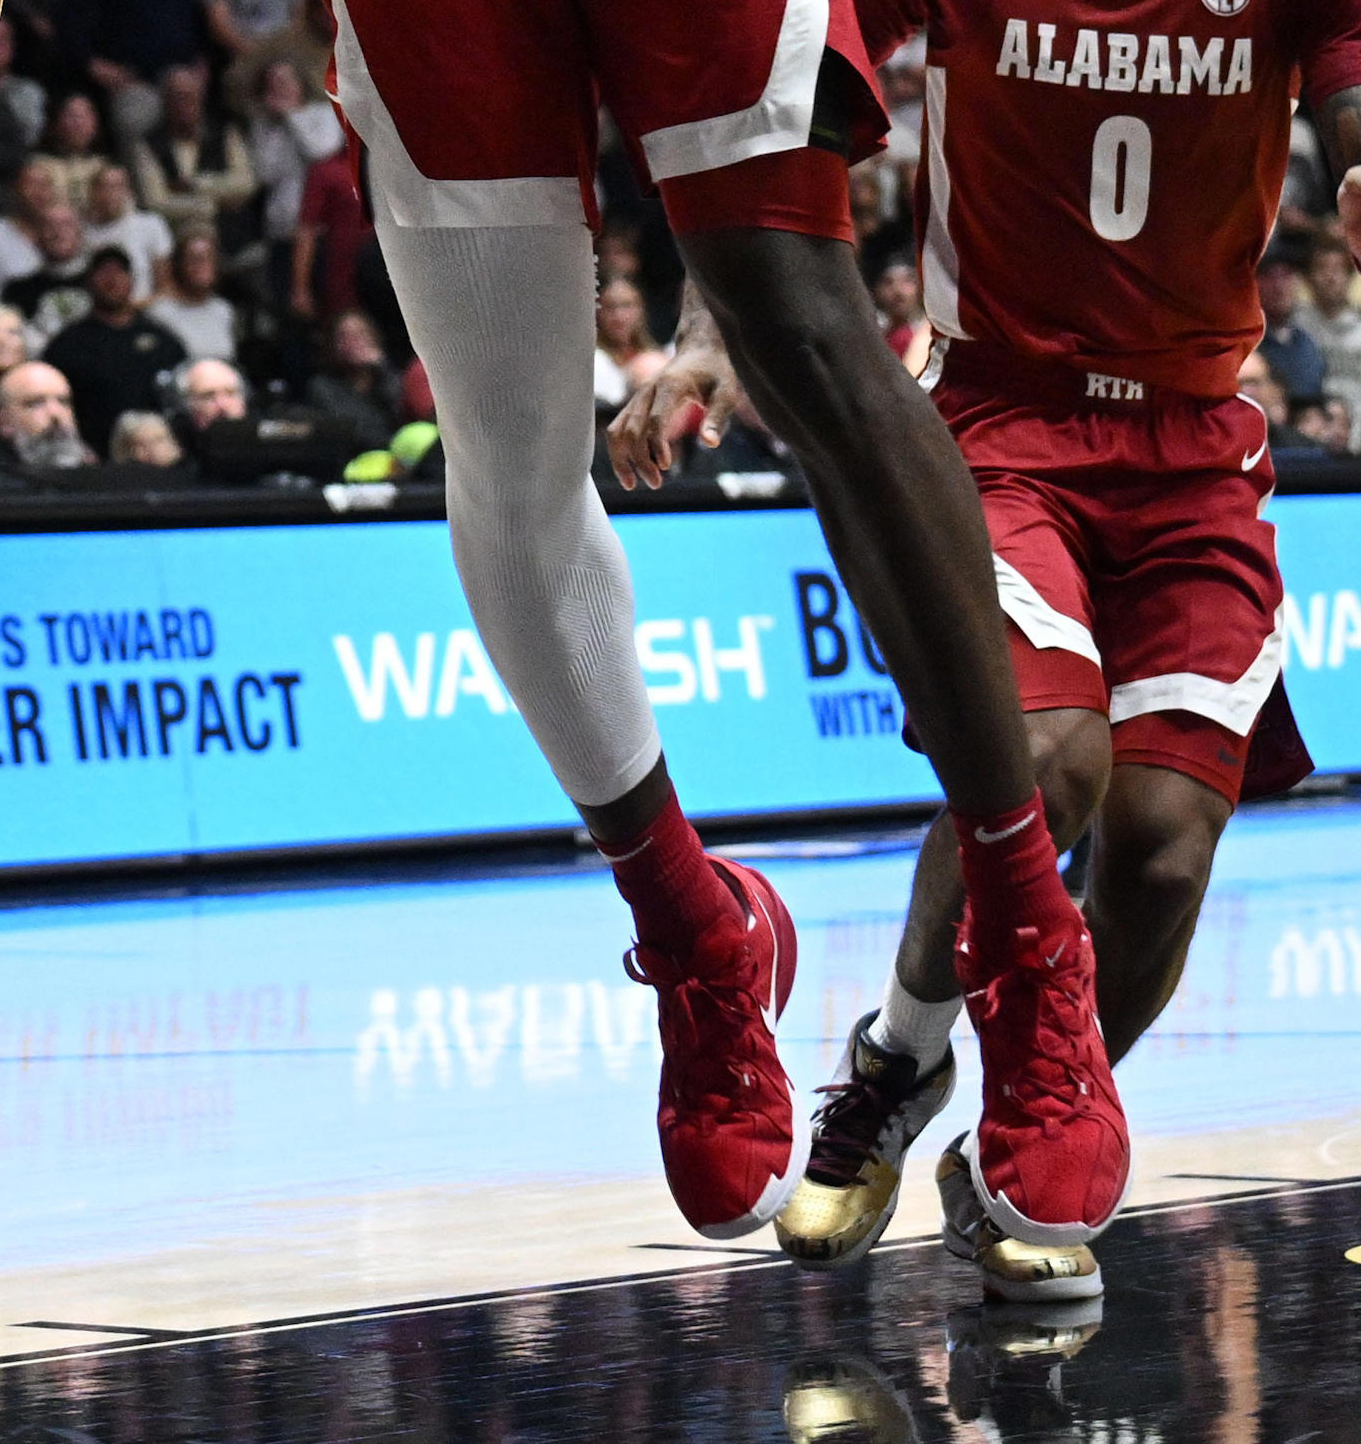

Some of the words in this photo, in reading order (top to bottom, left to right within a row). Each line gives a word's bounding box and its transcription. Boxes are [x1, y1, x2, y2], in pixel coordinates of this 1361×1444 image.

[996, 18, 1253, 96] ALABAMA
[1090, 115, 1152, 242] 0
[38, 608, 216, 666] TOWARD
[332, 616, 768, 722] WASH
[70, 671, 302, 761] IMPACT
[811, 690, 897, 738] WITH
